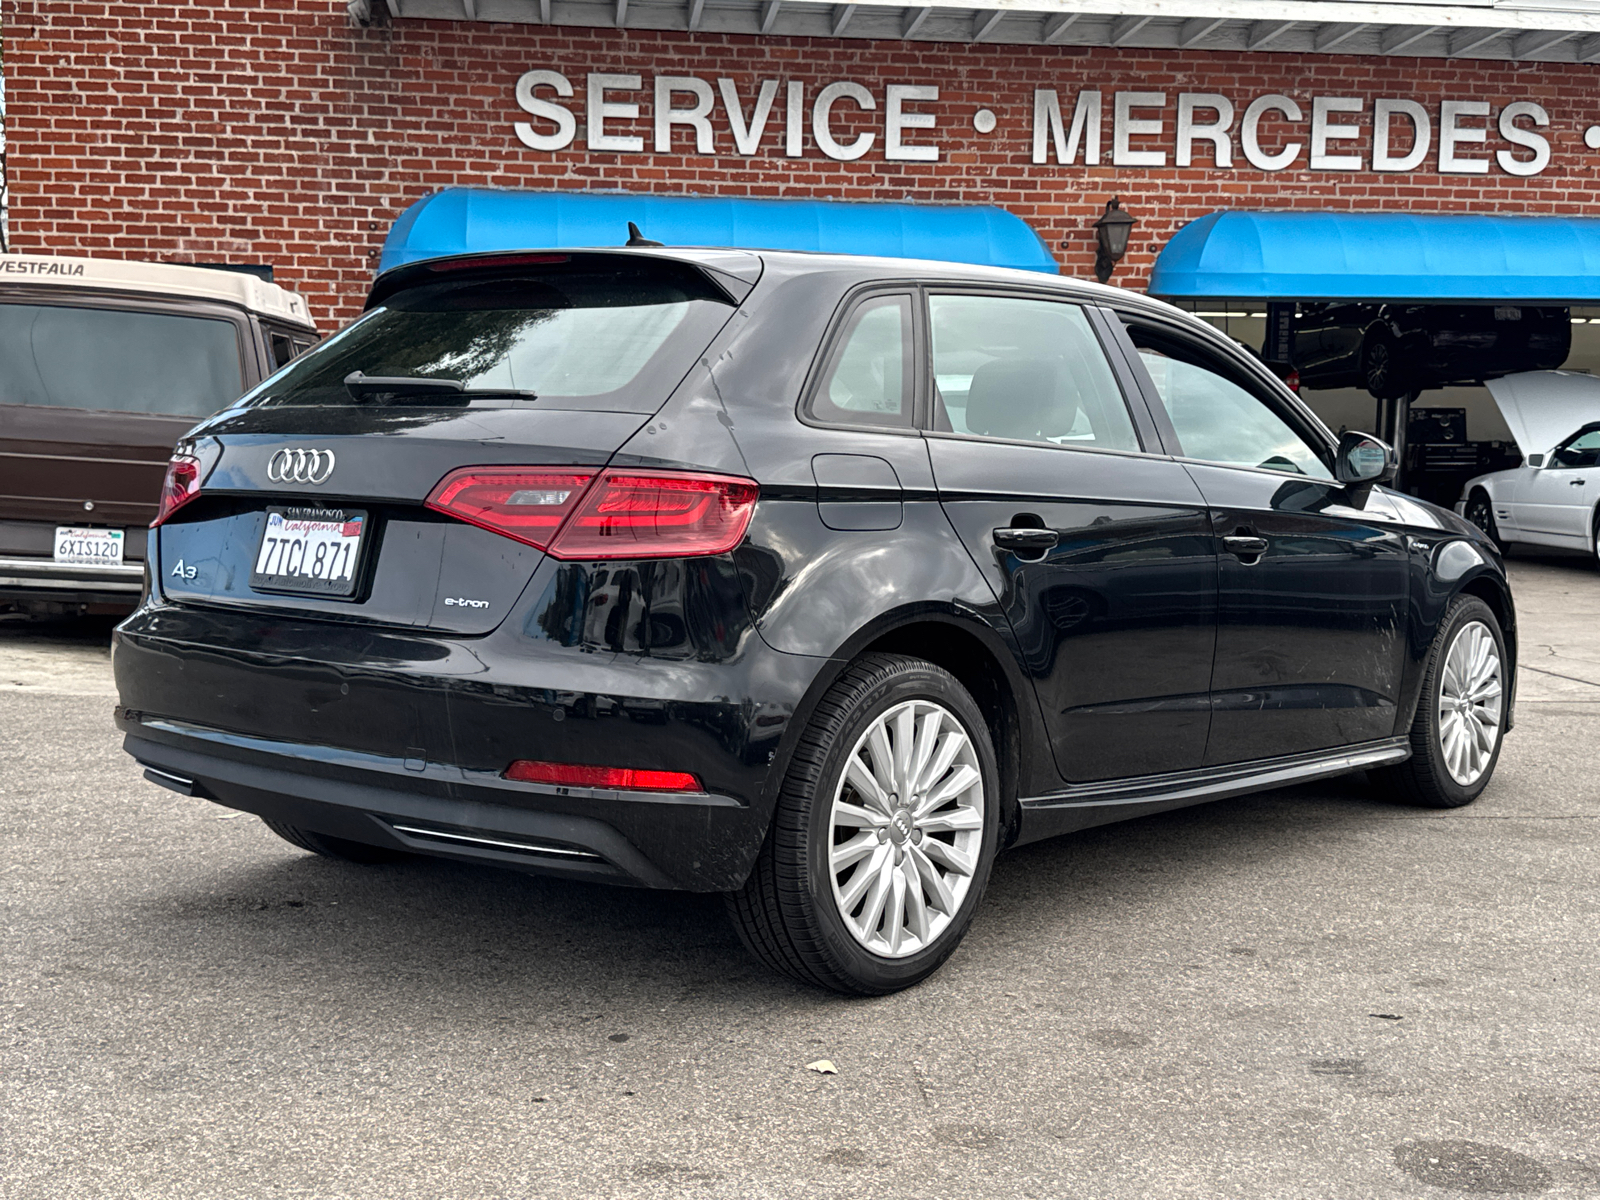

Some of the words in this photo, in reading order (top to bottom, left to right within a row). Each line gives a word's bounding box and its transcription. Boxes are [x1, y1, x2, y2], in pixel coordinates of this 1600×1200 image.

[513, 69, 940, 162] SERVICE
[1031, 89, 1552, 176] MERCEDES
[284, 519, 344, 537] California
[59, 540, 118, 557] 6XIS120
[263, 537, 351, 580] 7TCL871
[171, 559, 197, 579] A3
[444, 597, 490, 609] e-tron
